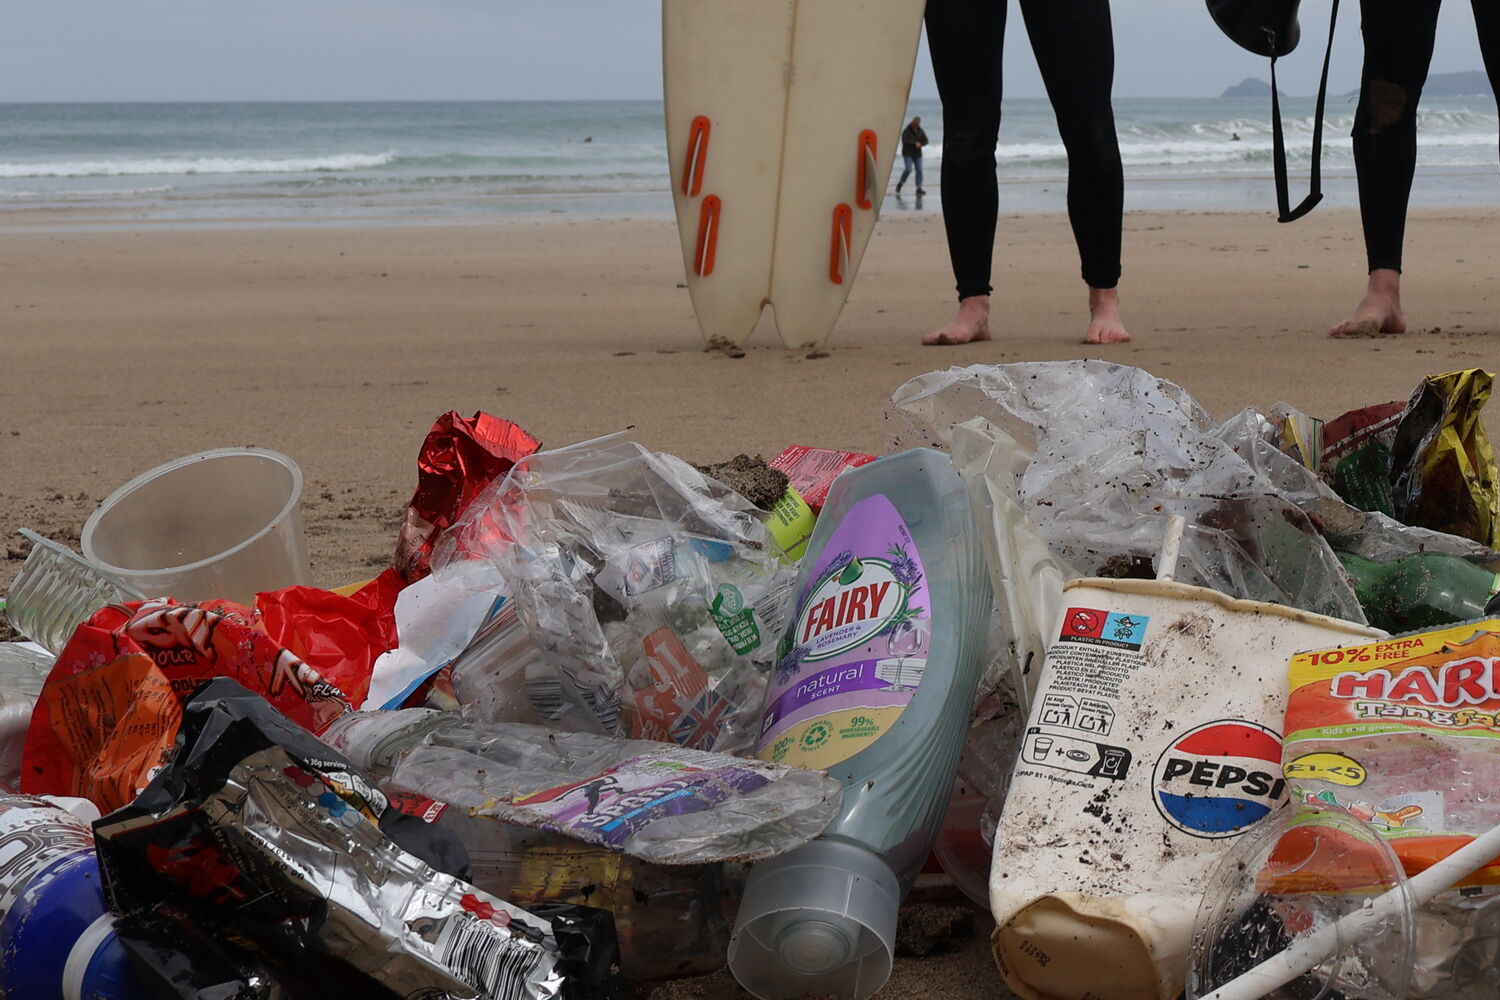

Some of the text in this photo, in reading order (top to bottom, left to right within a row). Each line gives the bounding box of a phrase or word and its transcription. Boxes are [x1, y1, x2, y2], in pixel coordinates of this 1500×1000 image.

[802, 580, 893, 644] FAIRY
[816, 627, 854, 646] LAVENDER
[817, 631, 858, 650] ROSEMARY
[1070, 636, 1094, 644] PLASTIC
[1101, 640, 1129, 648] PRODUCT
[1106, 650, 1145, 660] KUNSTSTOFF
[1296, 638, 1424, 667] +10% EXTRA
[1375, 650, 1410, 661] FREE
[1056, 660, 1084, 668] PLASTICA
[1097, 664, 1129, 674] PRODOTTO
[1114, 656, 1148, 667] PLASTIQUE
[1121, 662, 1140, 671] PLAST
[1098, 670, 1131, 680] PRODUCTO
[796, 664, 865, 698] natural
[1053, 680, 1088, 688] PLAISTEACH
[1084, 679, 1119, 688] PRODUKTET
[810, 684, 842, 700] SCENT
[1096, 691, 1121, 700] PLASTIC
[850, 716, 875, 728] 99%
[1322, 726, 1344, 735] Kids
[310, 759, 322, 769] 30g
[1048, 775, 1076, 785] Raccolta
[1162, 757, 1286, 800] PEPSI
